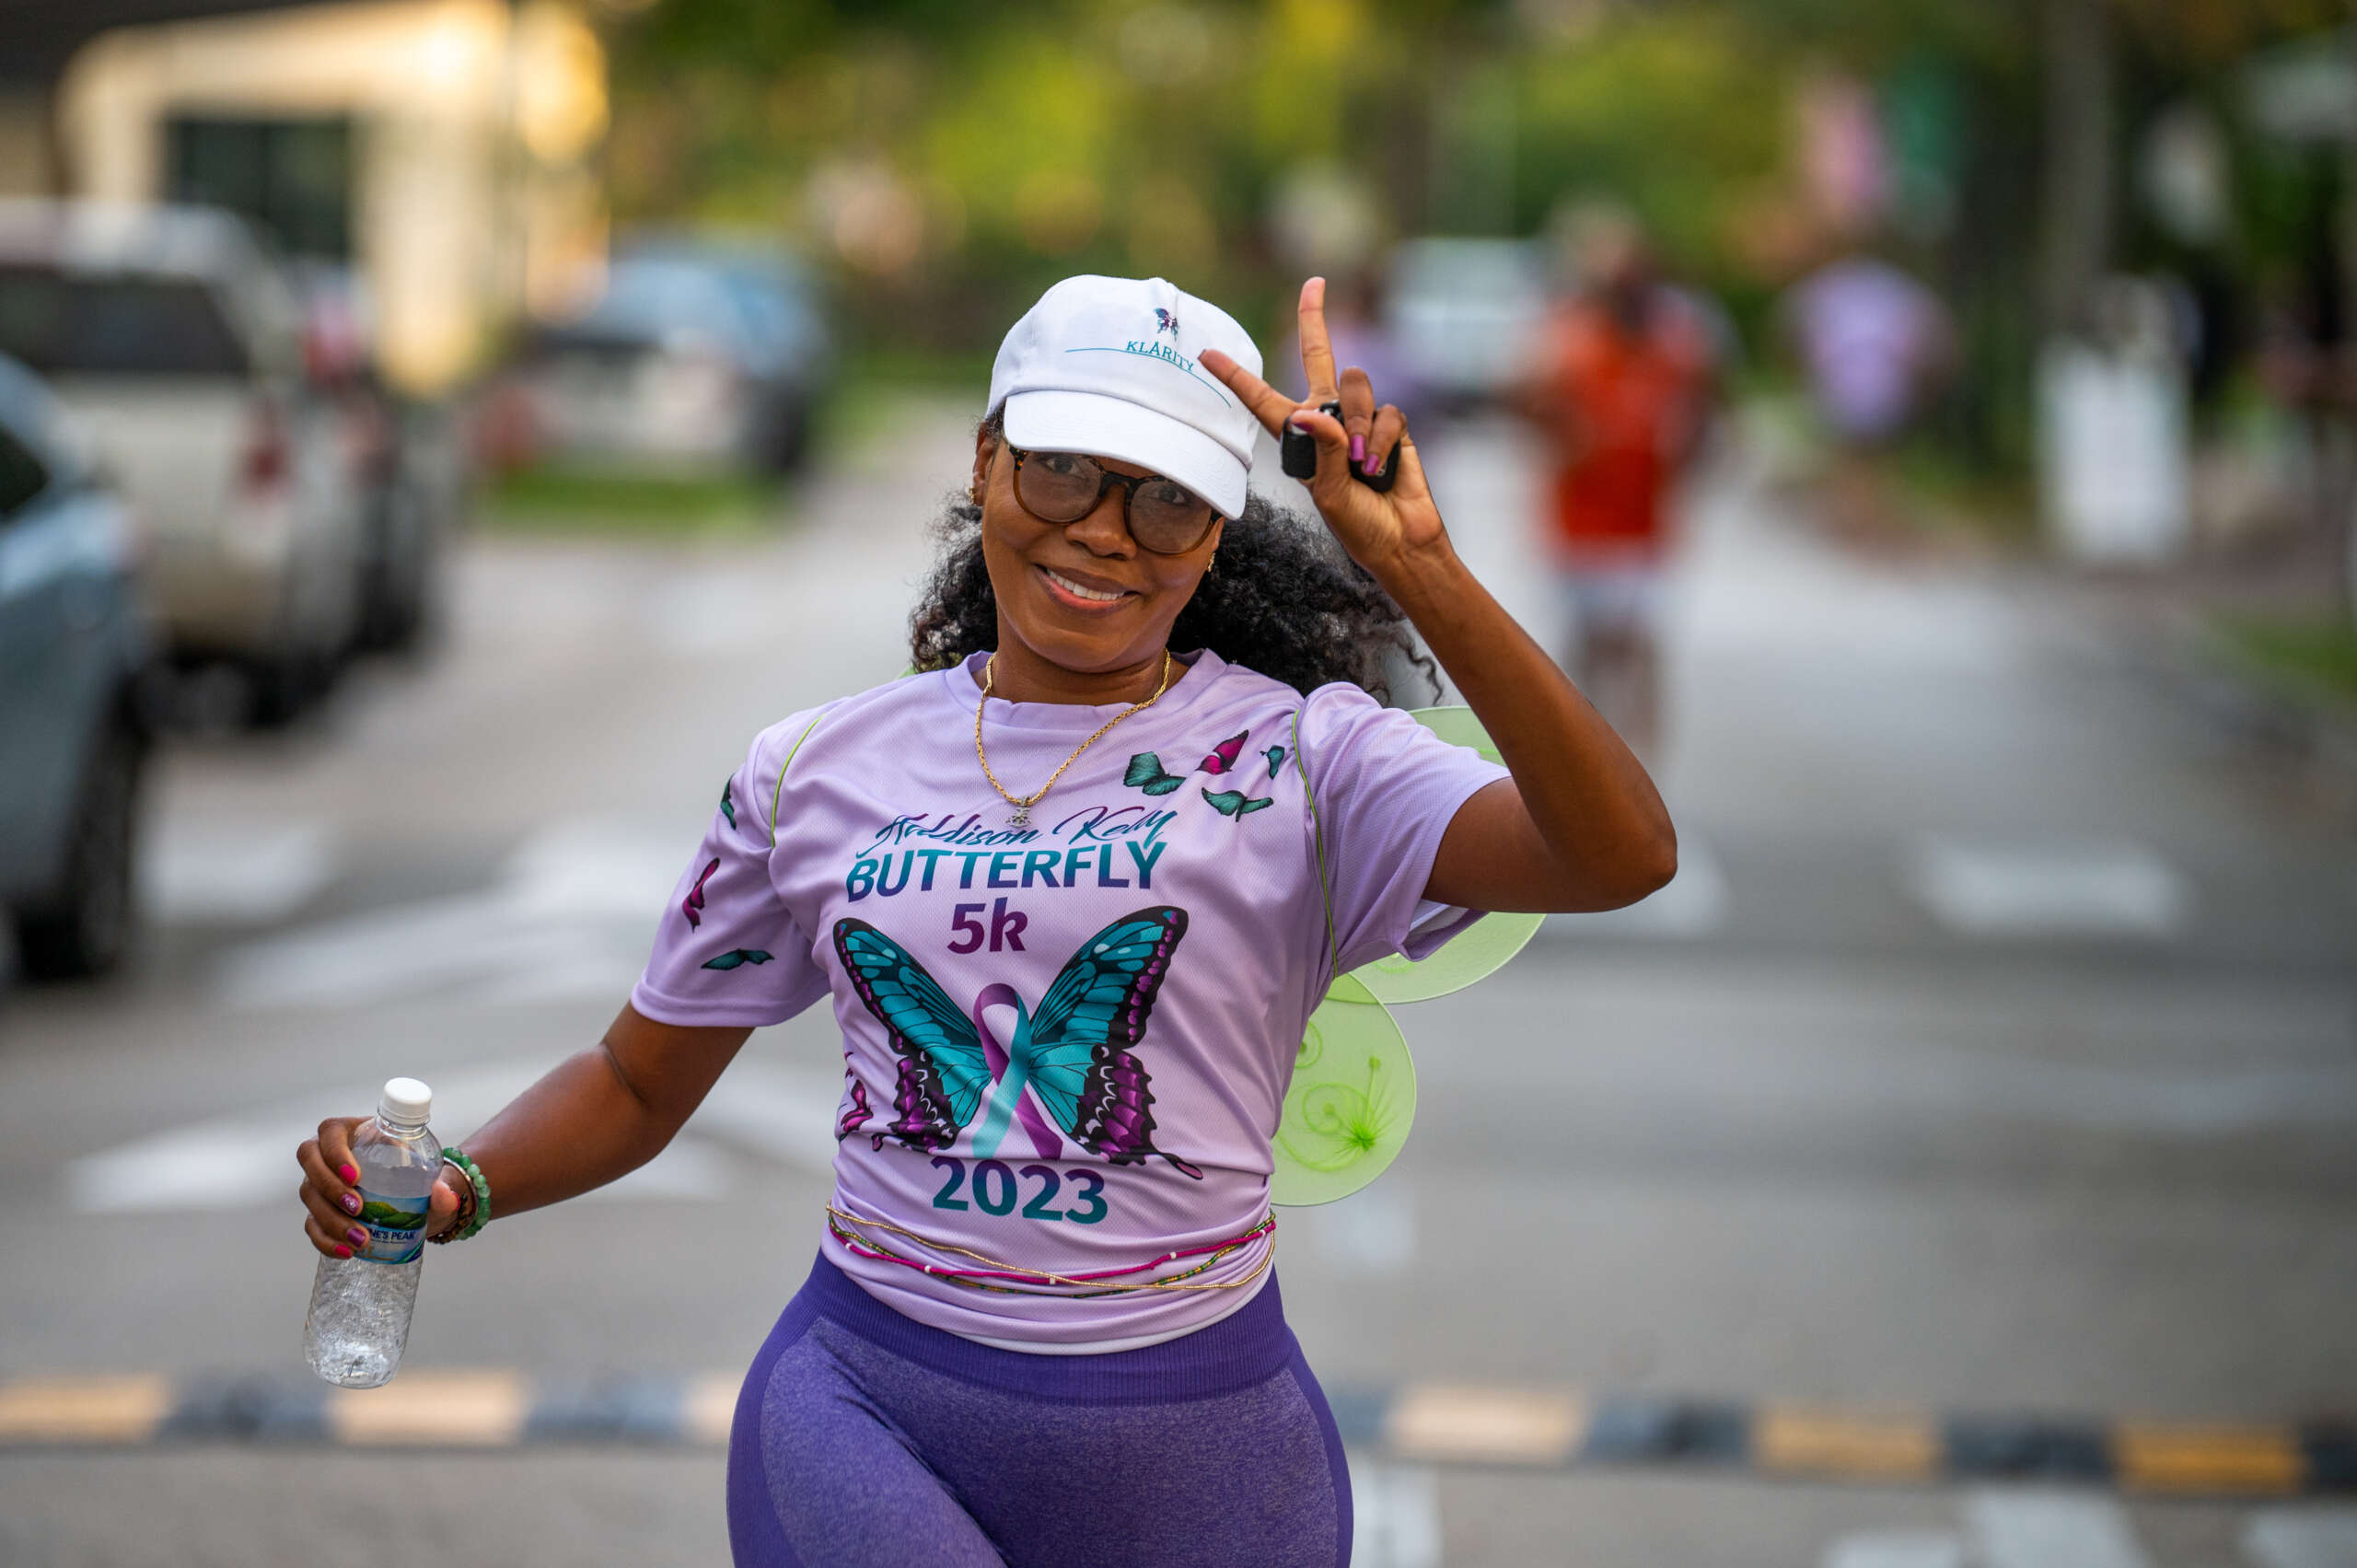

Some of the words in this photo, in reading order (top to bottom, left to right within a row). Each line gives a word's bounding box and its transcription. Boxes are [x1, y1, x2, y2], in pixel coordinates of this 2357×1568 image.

[1126, 341, 1194, 372] KLARITY
[1051, 806, 1178, 850] Kelly
[846, 841, 1167, 902] BUTTERFLY
[930, 1156, 1109, 1225] 2023
